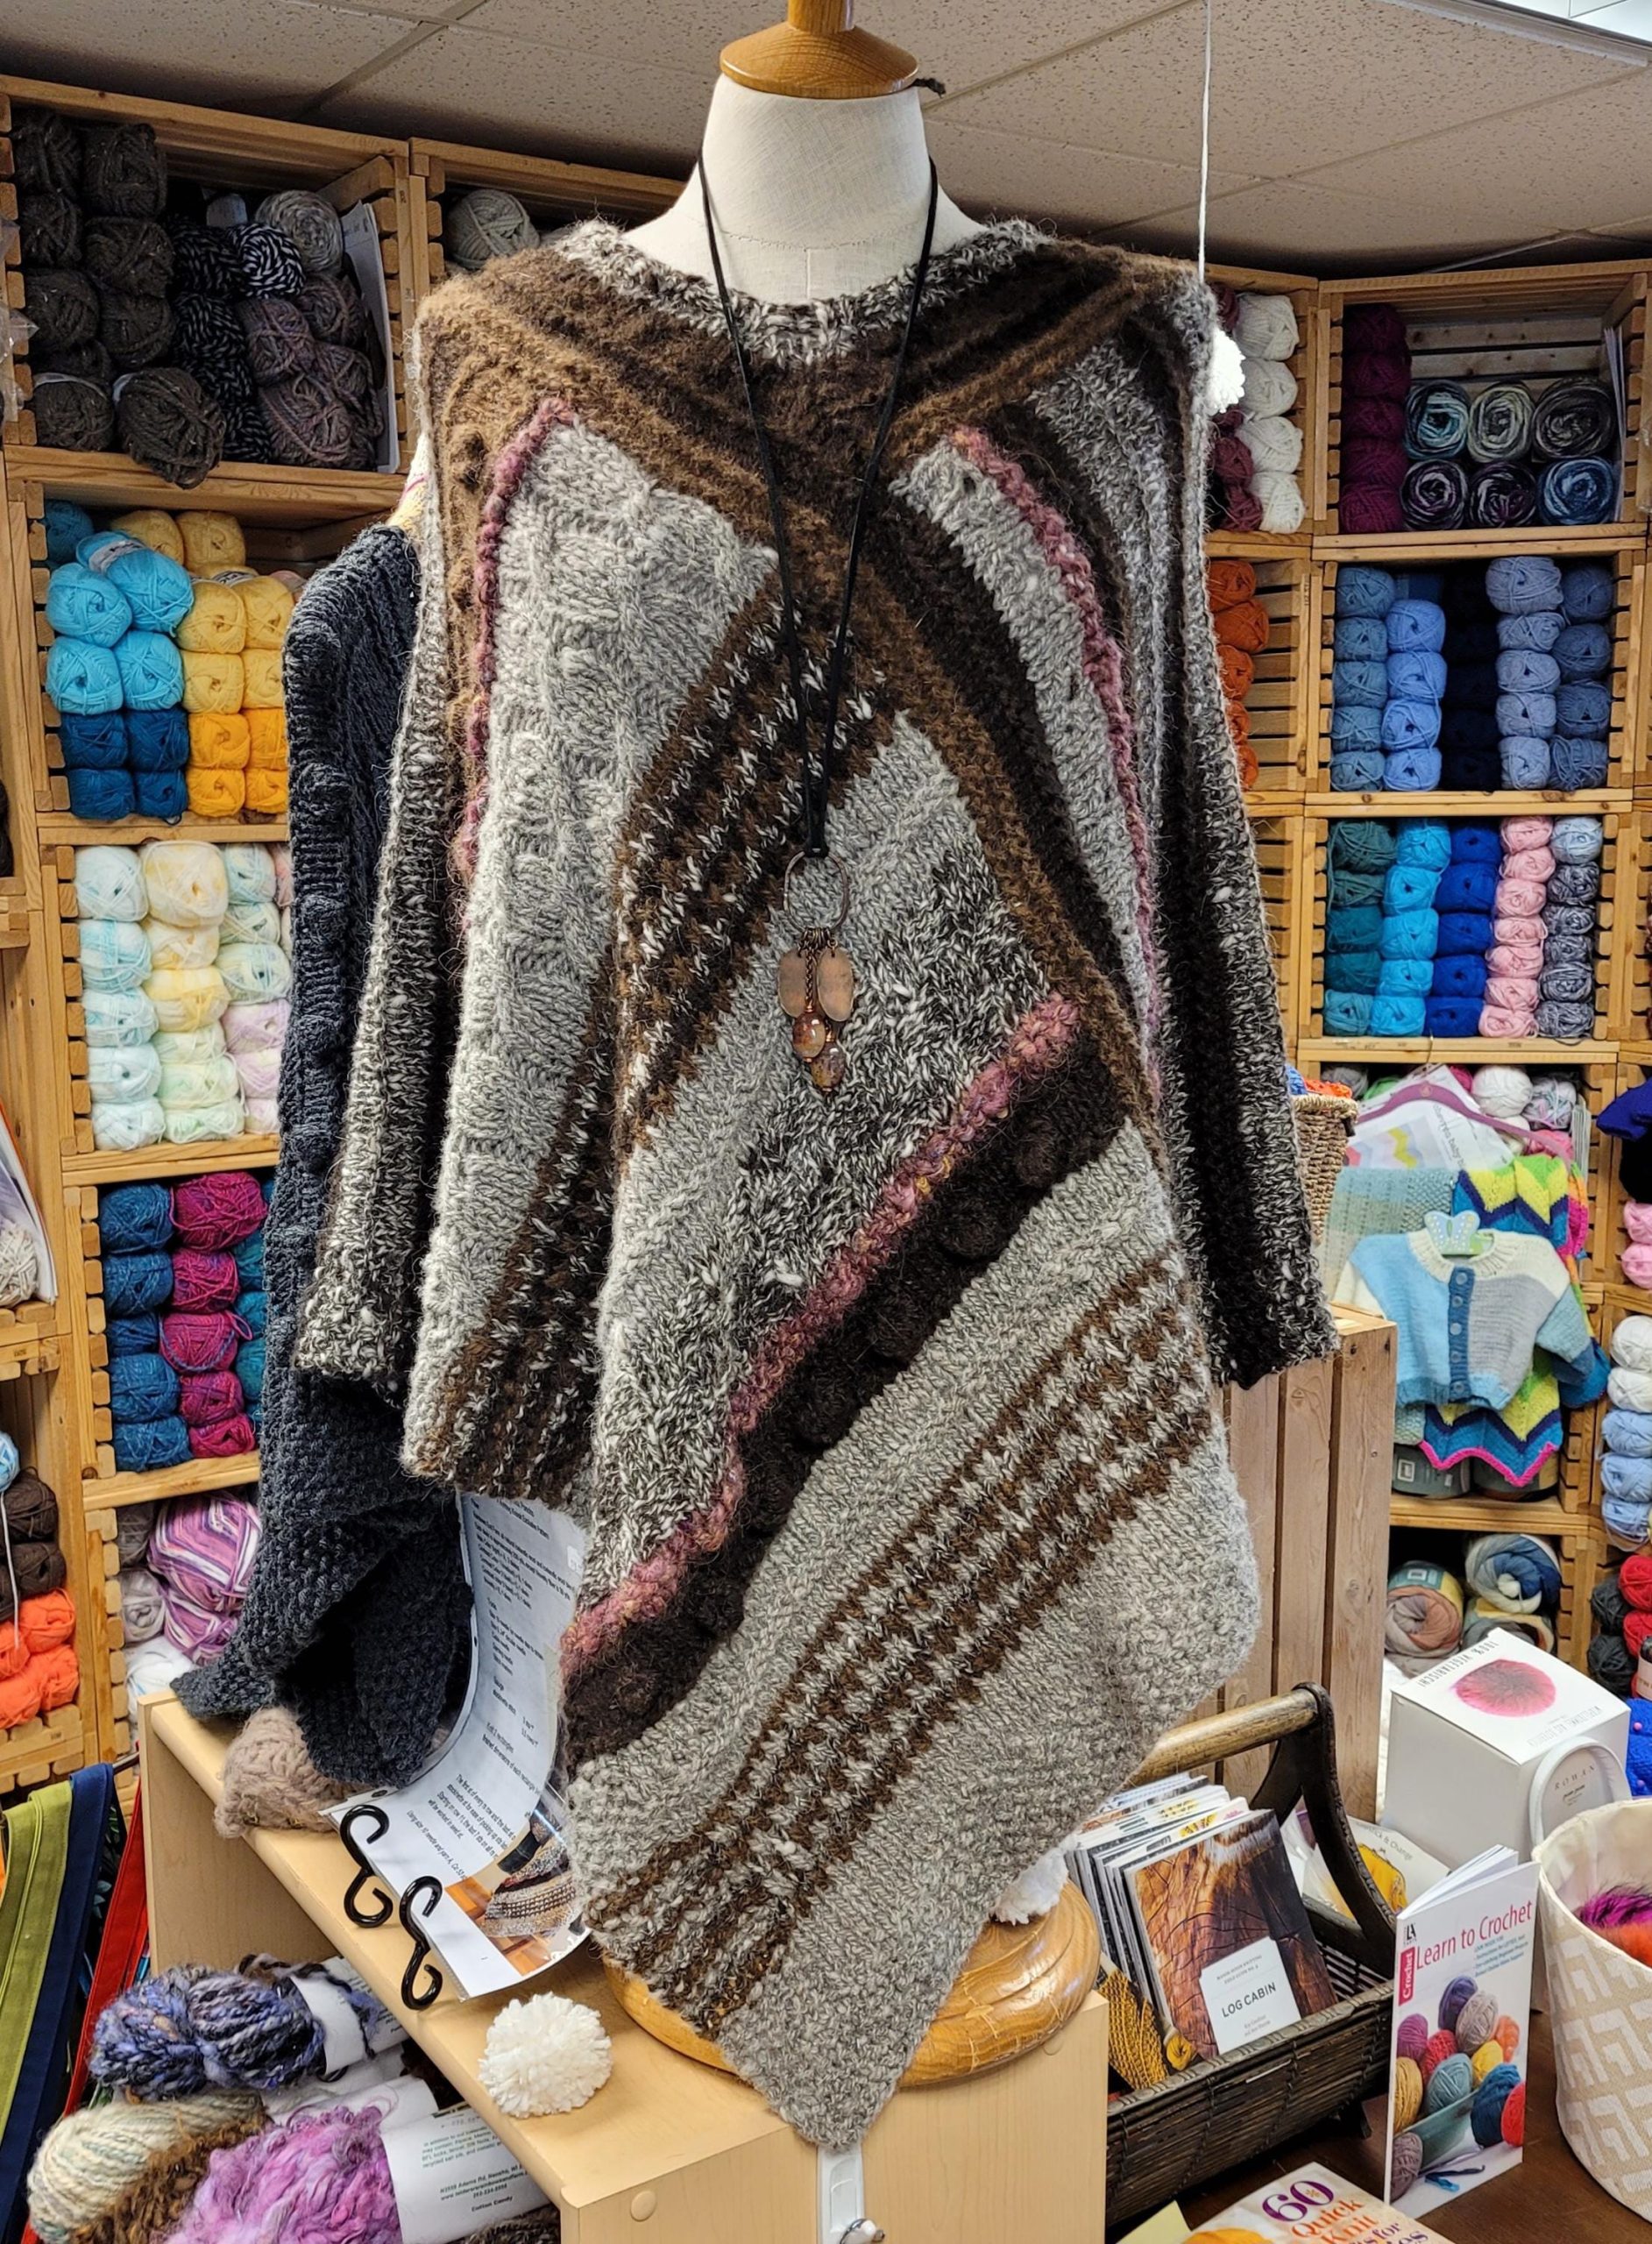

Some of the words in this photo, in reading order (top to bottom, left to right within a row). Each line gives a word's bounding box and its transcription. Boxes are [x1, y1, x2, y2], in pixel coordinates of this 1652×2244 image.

[1416, 1936, 1456, 1971] Learn
[1461, 1928, 1475, 1949] to
[1479, 1900, 1532, 1941] Crochet
[1402, 1952, 1413, 1999] Crochet
[1222, 2000, 1243, 2017] LOG
[1244, 1982, 1276, 2006] CABIN
[471, 2202, 492, 2212] Cotton
[493, 2196, 514, 2205] Candy
[1263, 2180, 1334, 2222] 60
[1291, 2198, 1365, 2238] Quick
[1321, 2215, 1379, 2244] Knit
[1372, 2222, 1402, 2240] for
